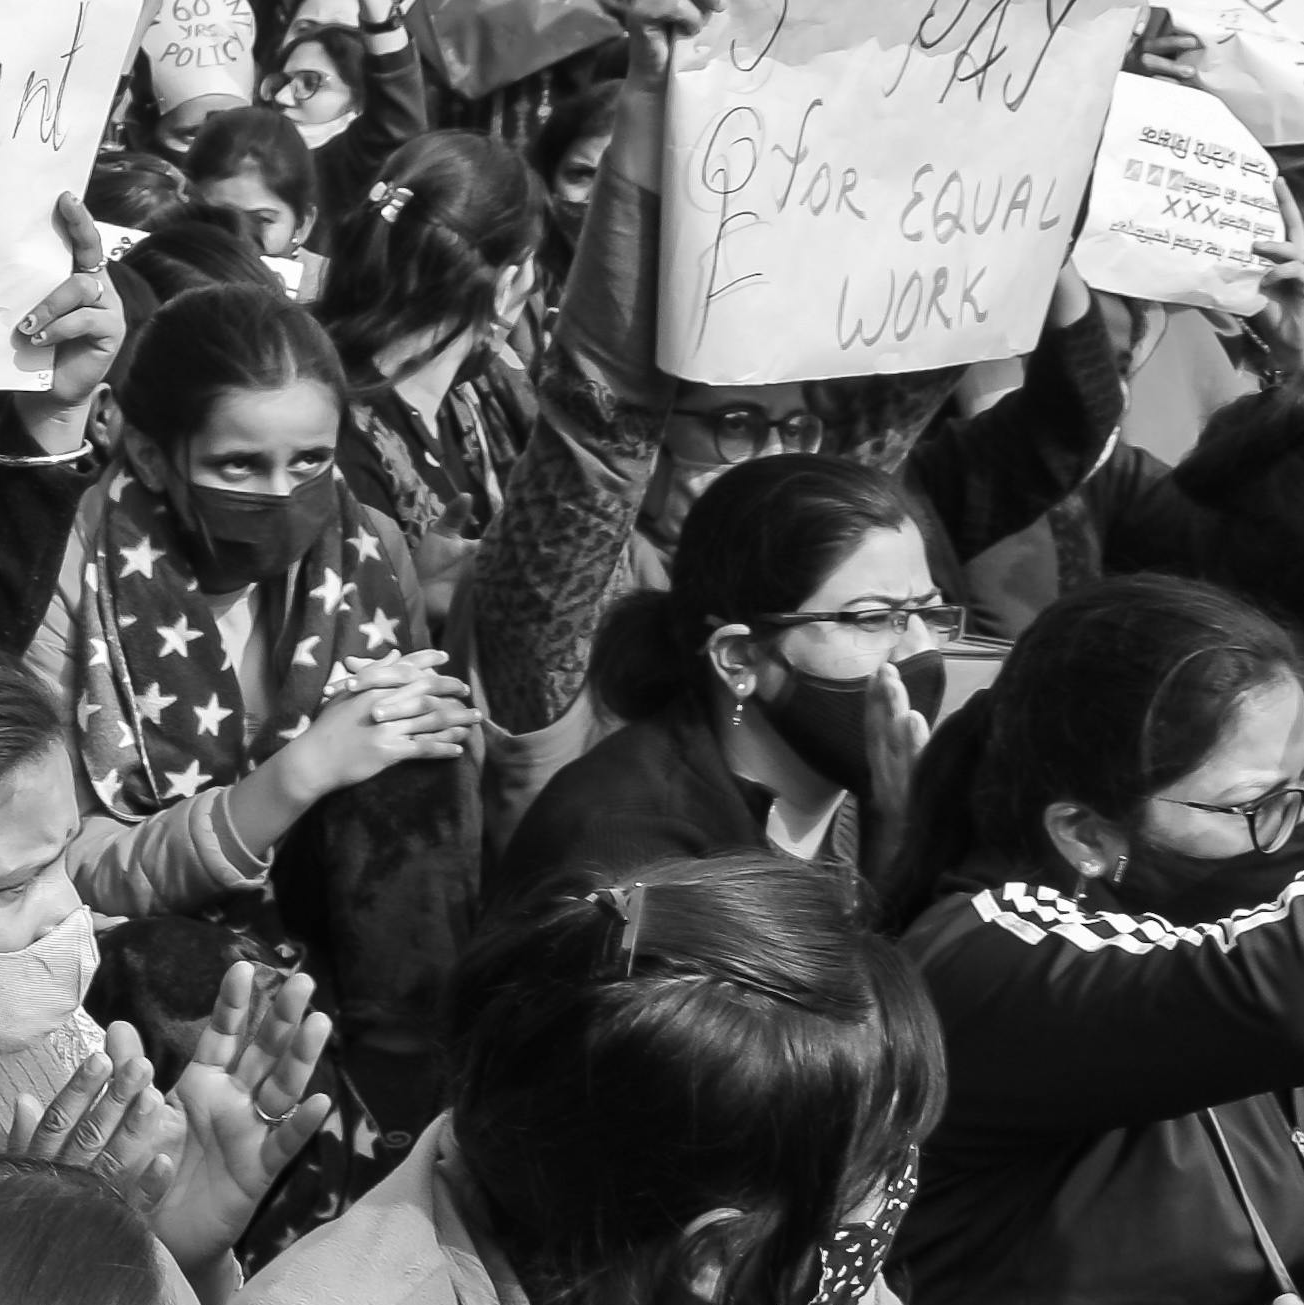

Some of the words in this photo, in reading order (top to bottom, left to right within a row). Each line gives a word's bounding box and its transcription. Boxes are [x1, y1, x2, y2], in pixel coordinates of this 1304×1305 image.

[159, 31, 245, 68] POLICY
[900, 163, 1062, 245] EQUAL
[838, 266, 990, 351] WORK
